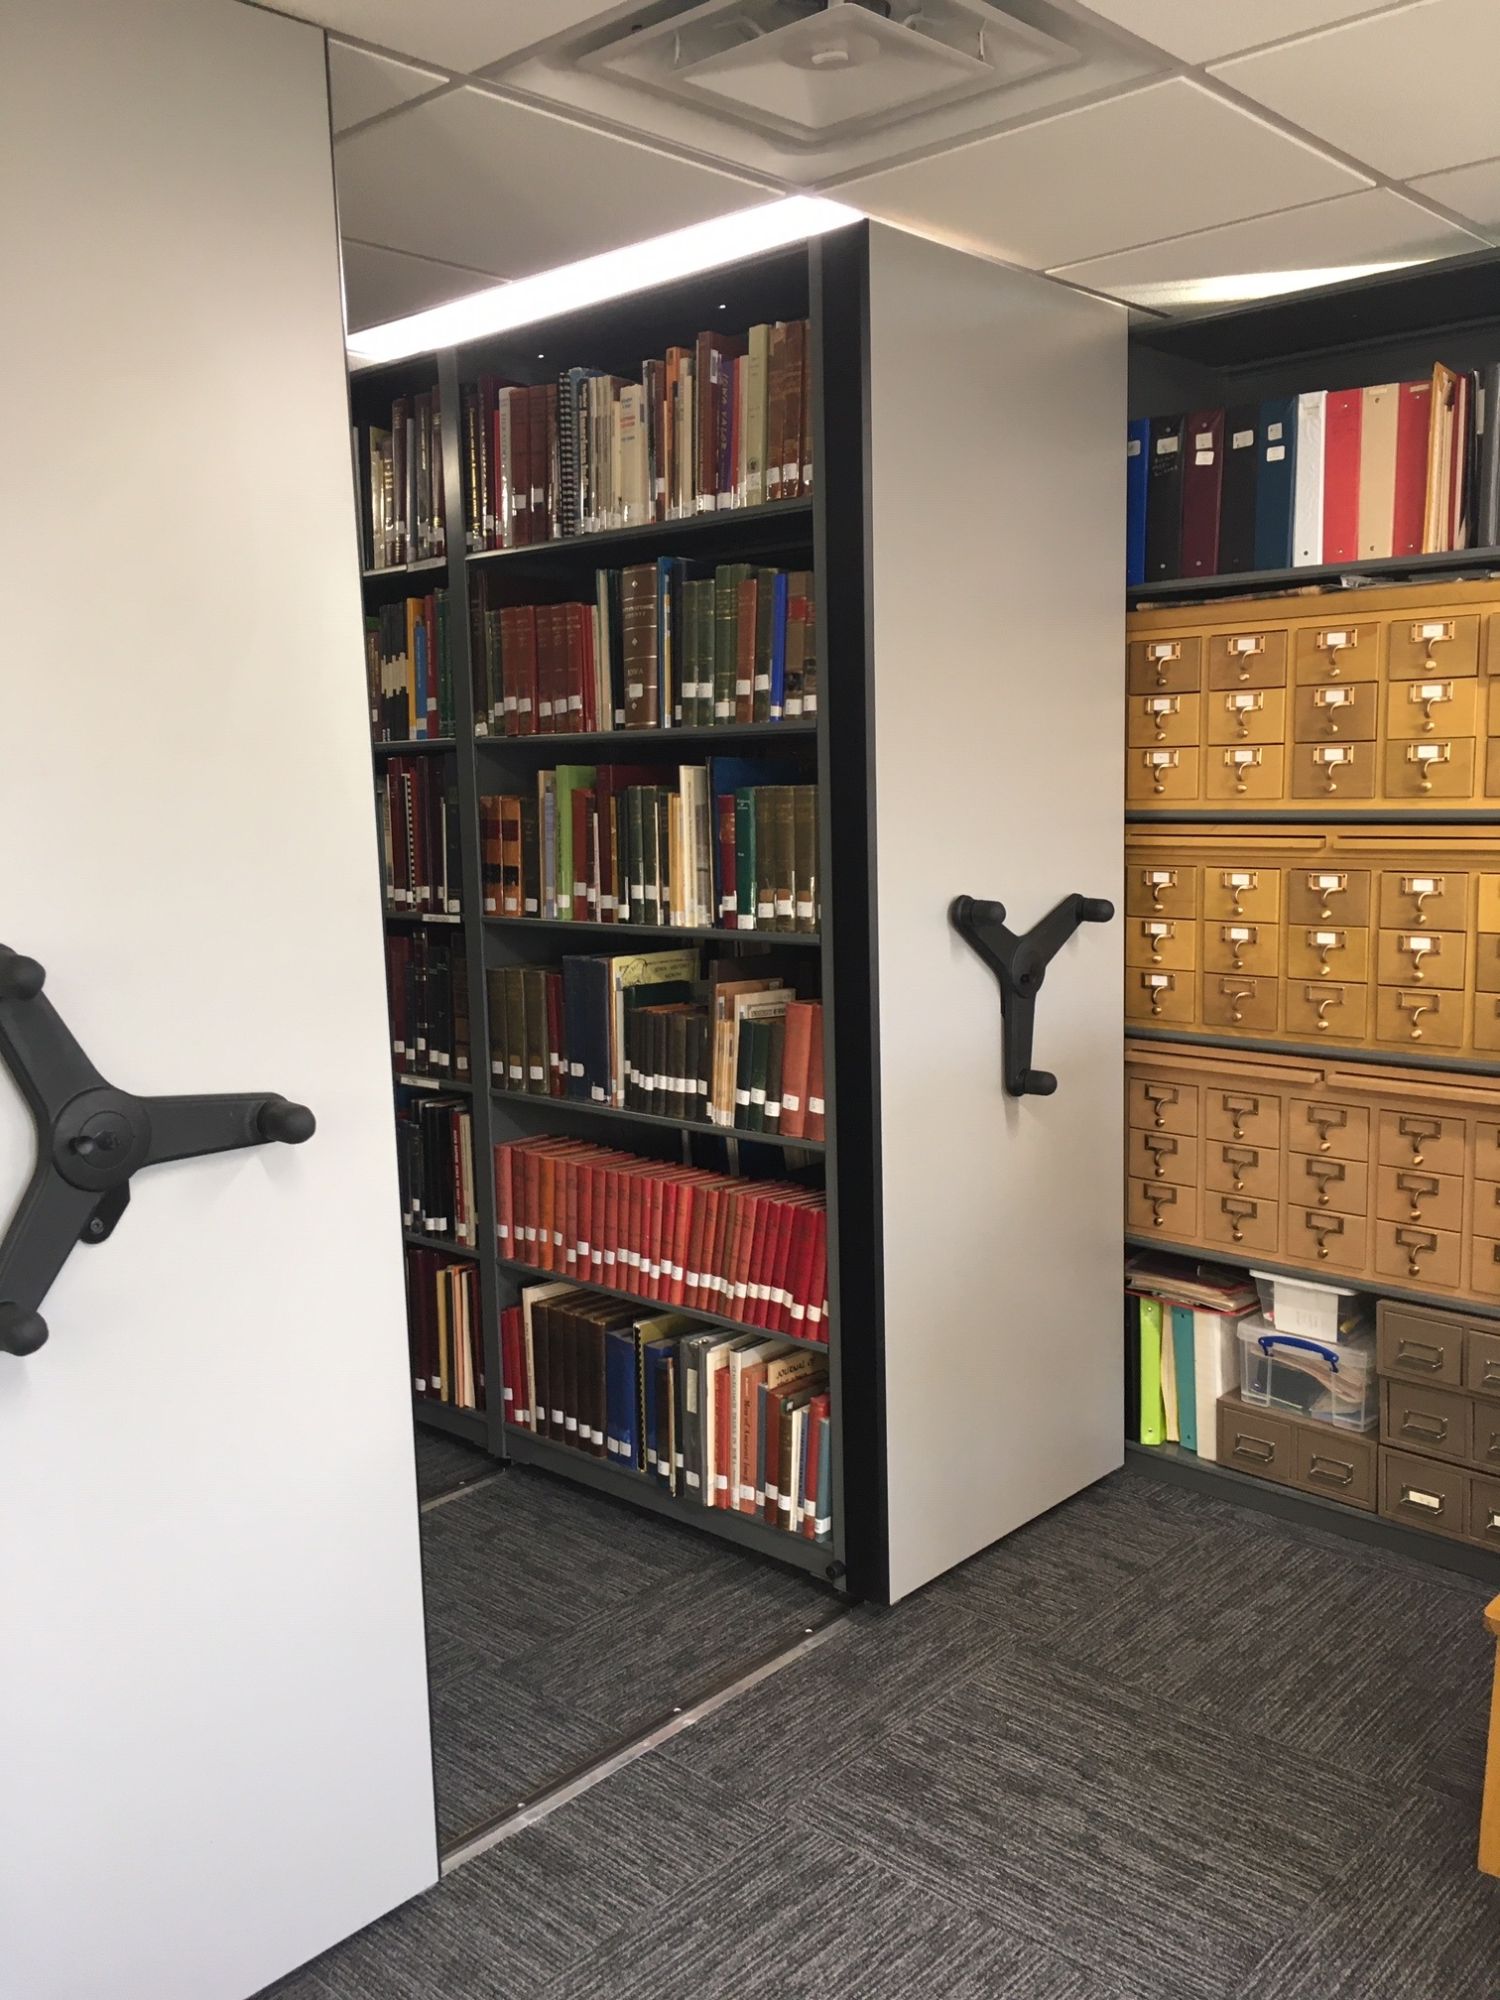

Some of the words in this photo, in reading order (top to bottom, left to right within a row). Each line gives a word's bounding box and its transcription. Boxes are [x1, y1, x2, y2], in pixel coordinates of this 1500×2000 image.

[579, 410, 589, 464] American
[720, 409, 728, 450] VALOR
[580, 464, 589, 499] Indian
[743, 1428, 751, 1460] Ancient
